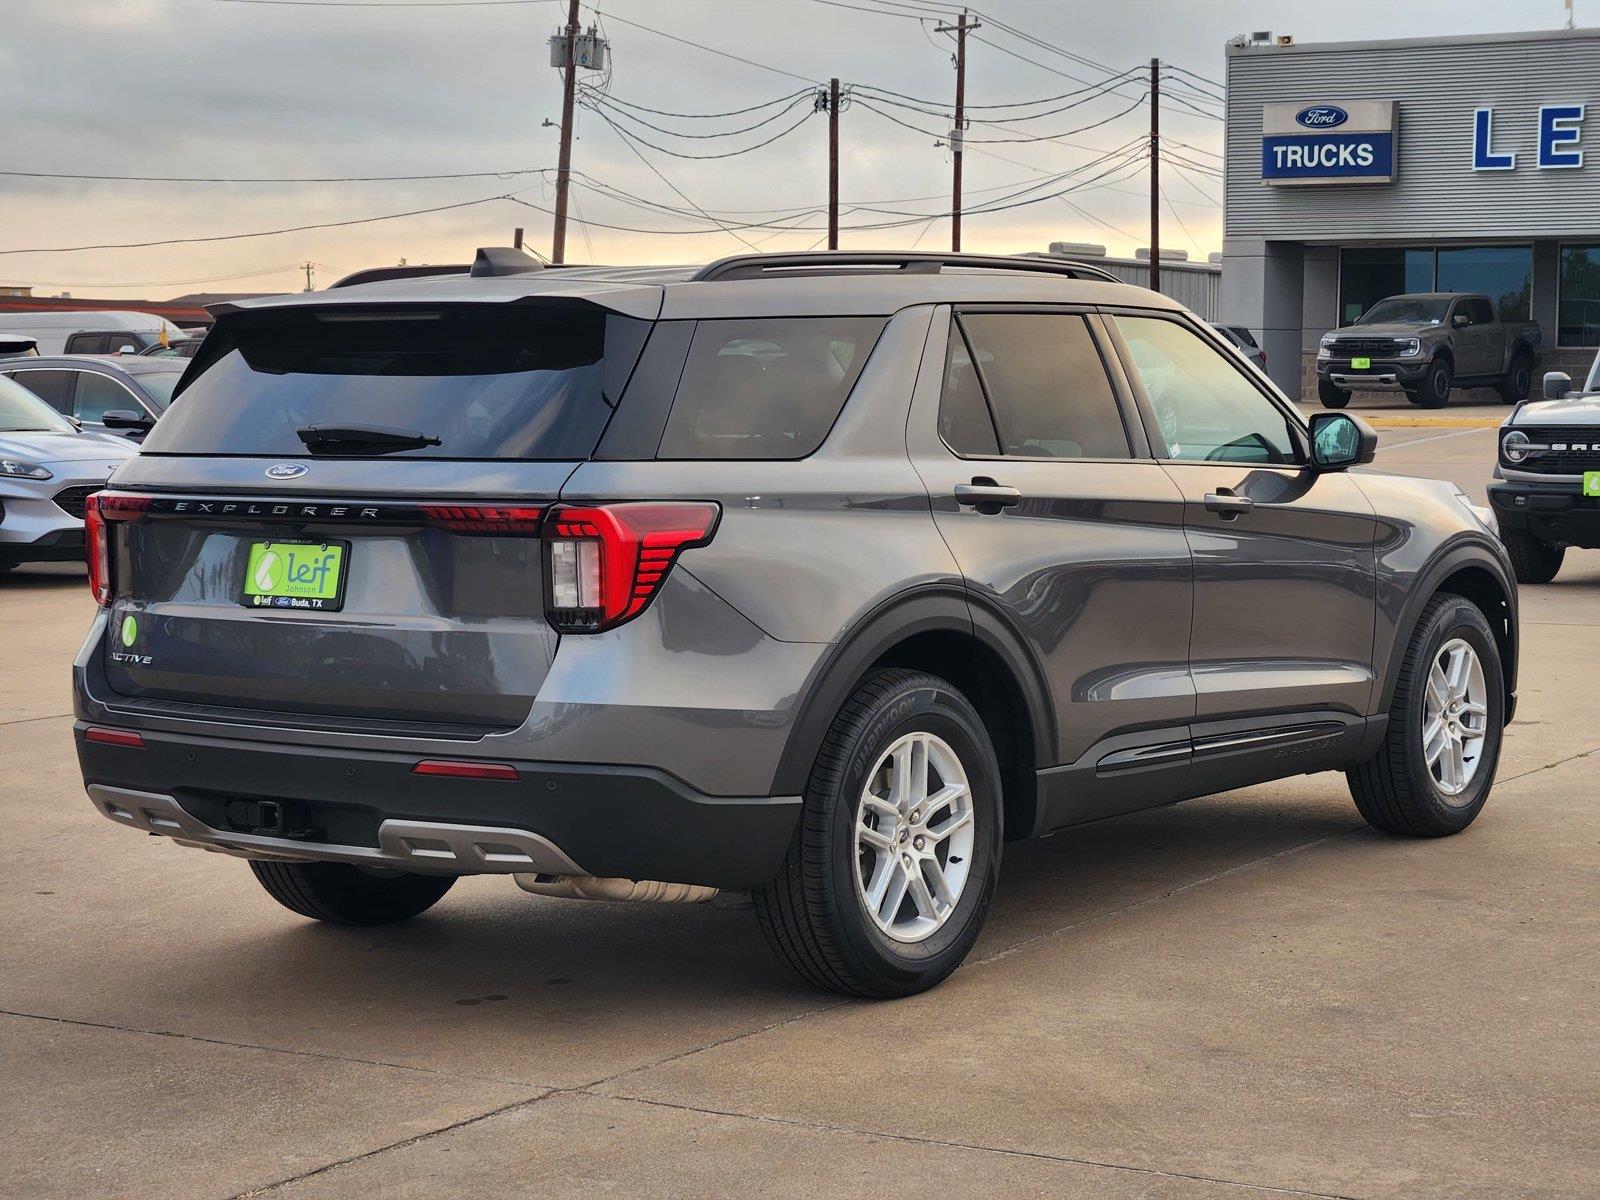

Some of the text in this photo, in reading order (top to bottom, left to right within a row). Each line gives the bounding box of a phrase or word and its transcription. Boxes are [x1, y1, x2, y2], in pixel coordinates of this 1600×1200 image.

[1304, 108, 1338, 124] Ford
[1472, 102, 1586, 172] LE
[1272, 143, 1375, 169] TRUCKS
[173, 502, 379, 518] EXPLORER
[285, 584, 316, 594] Johnson
[291, 597, 311, 608] Buda,
[312, 599, 323, 608] TX
[109, 652, 154, 665] ACTIVE
